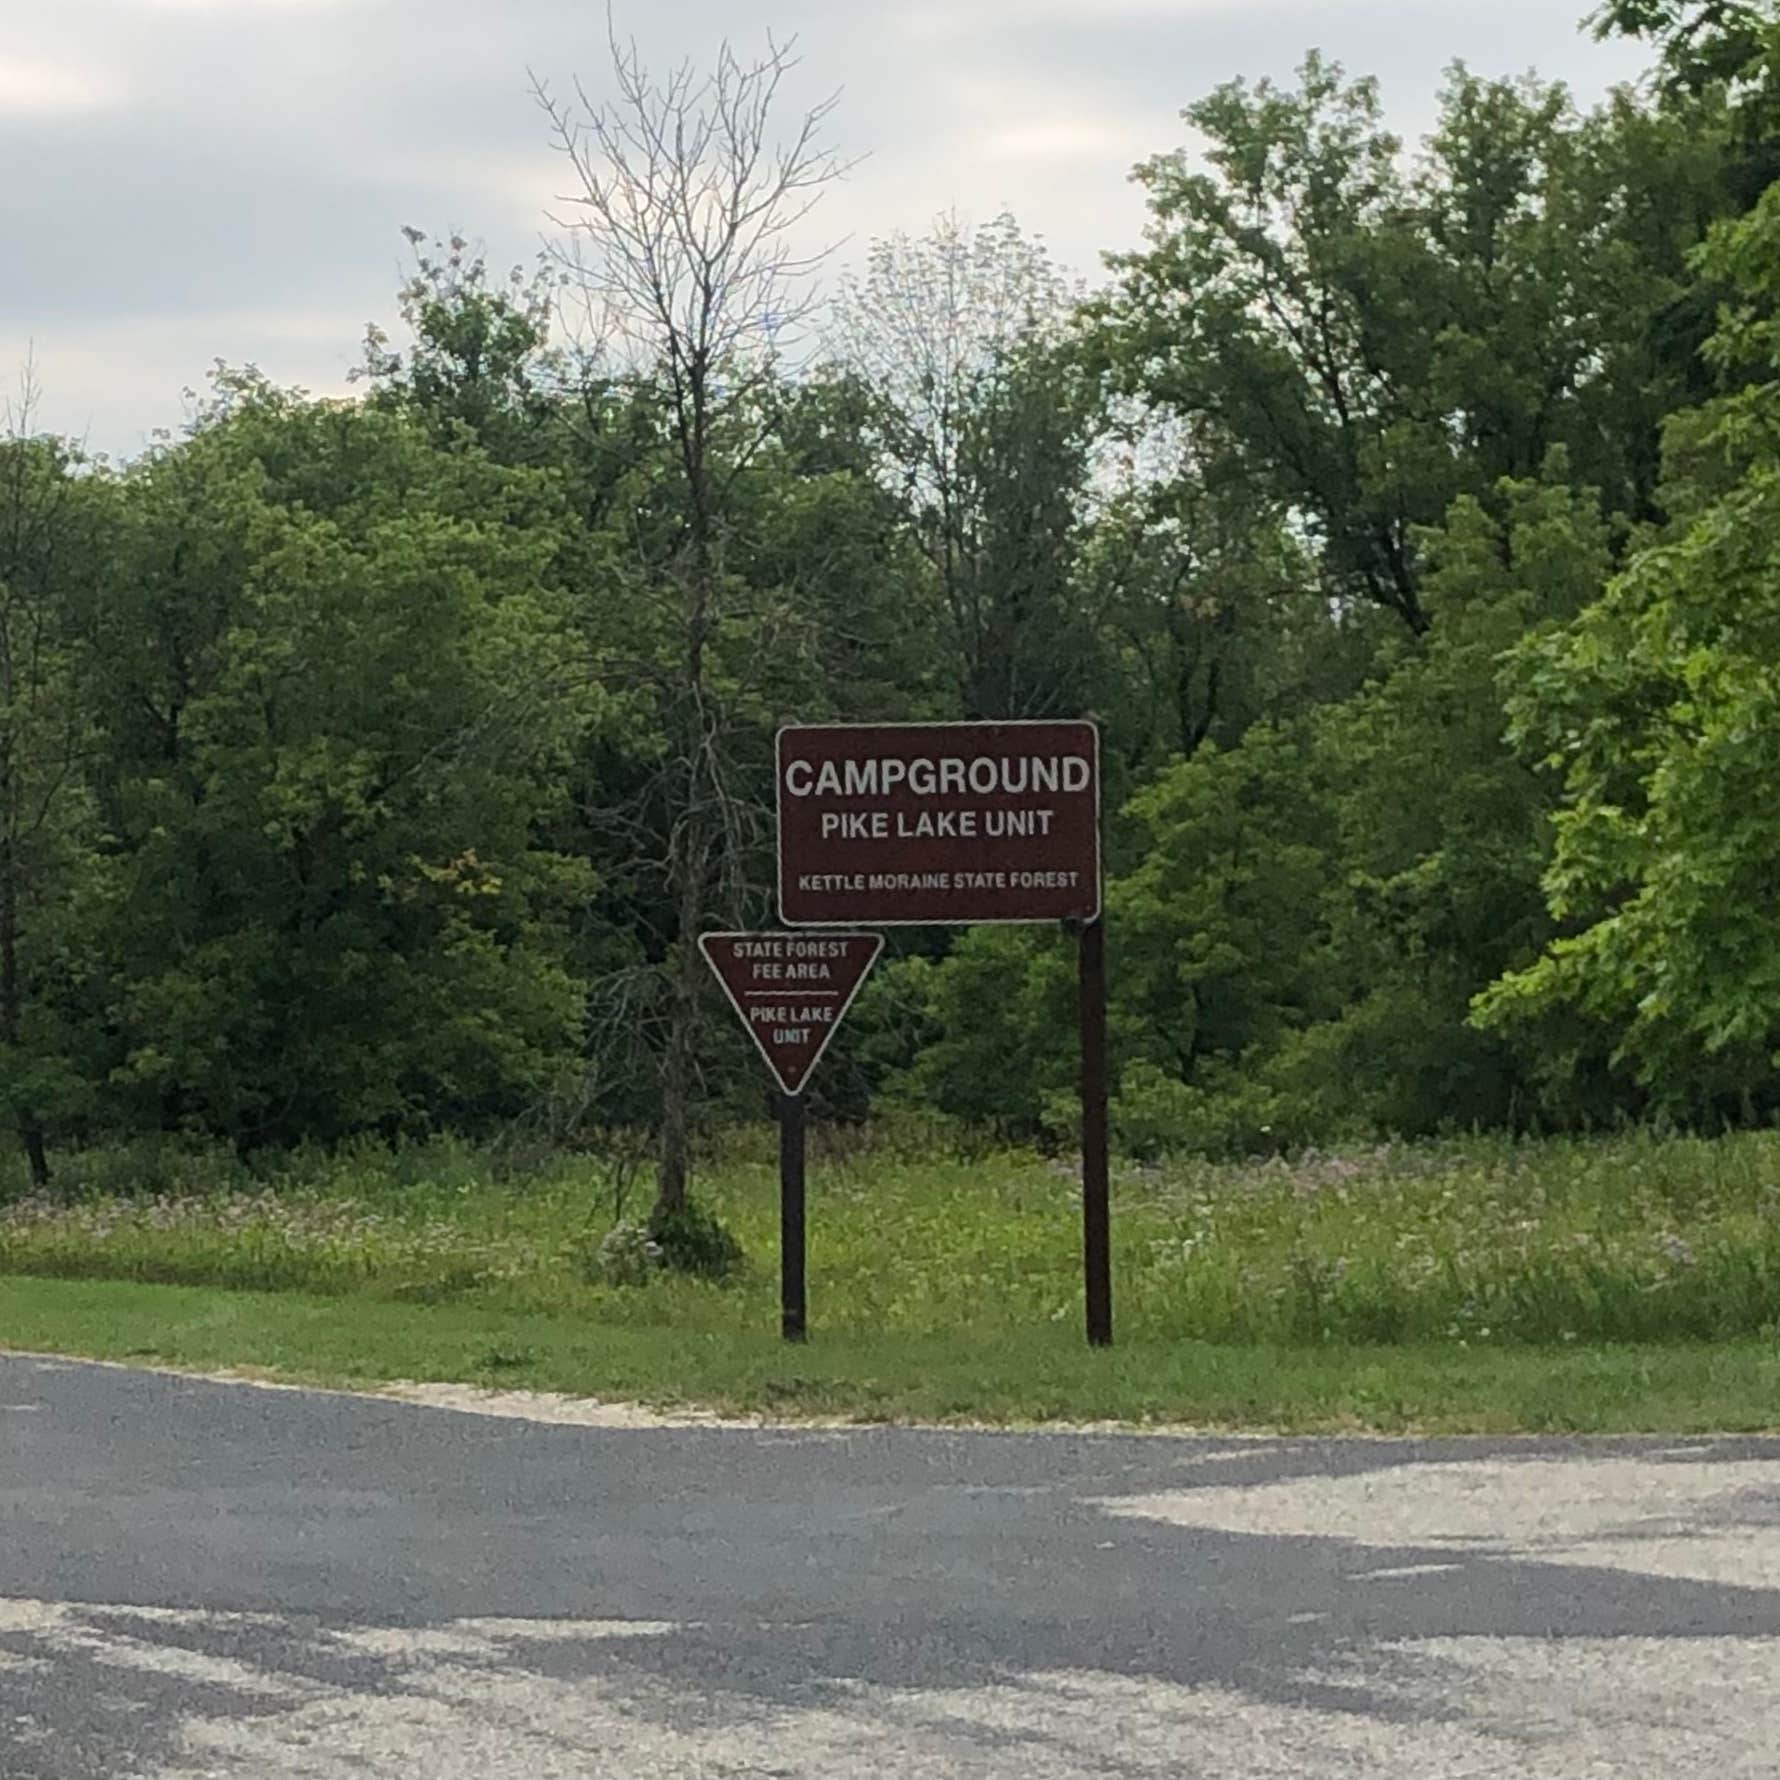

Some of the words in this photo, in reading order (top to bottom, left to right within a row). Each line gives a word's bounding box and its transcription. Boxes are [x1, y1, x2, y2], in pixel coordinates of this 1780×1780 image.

[785, 757, 1090, 796] CAMPGROUND
[822, 813, 888, 838] PIKE
[897, 812, 976, 837] LAKE
[986, 810, 1054, 836] UNIT
[799, 875, 865, 890] KETTLE
[869, 874, 949, 889] MORAINE
[954, 873, 1006, 888] STATE
[1011, 872, 1079, 887] FOREST
[733, 942, 782, 957] STATE
[786, 942, 848, 957] FOREST
[753, 964, 782, 979] FEE
[785, 964, 830, 979] AREA
[750, 1007, 786, 1022] PIKE
[790, 1007, 833, 1022] LAKE
[773, 1028, 810, 1043] UNIT
